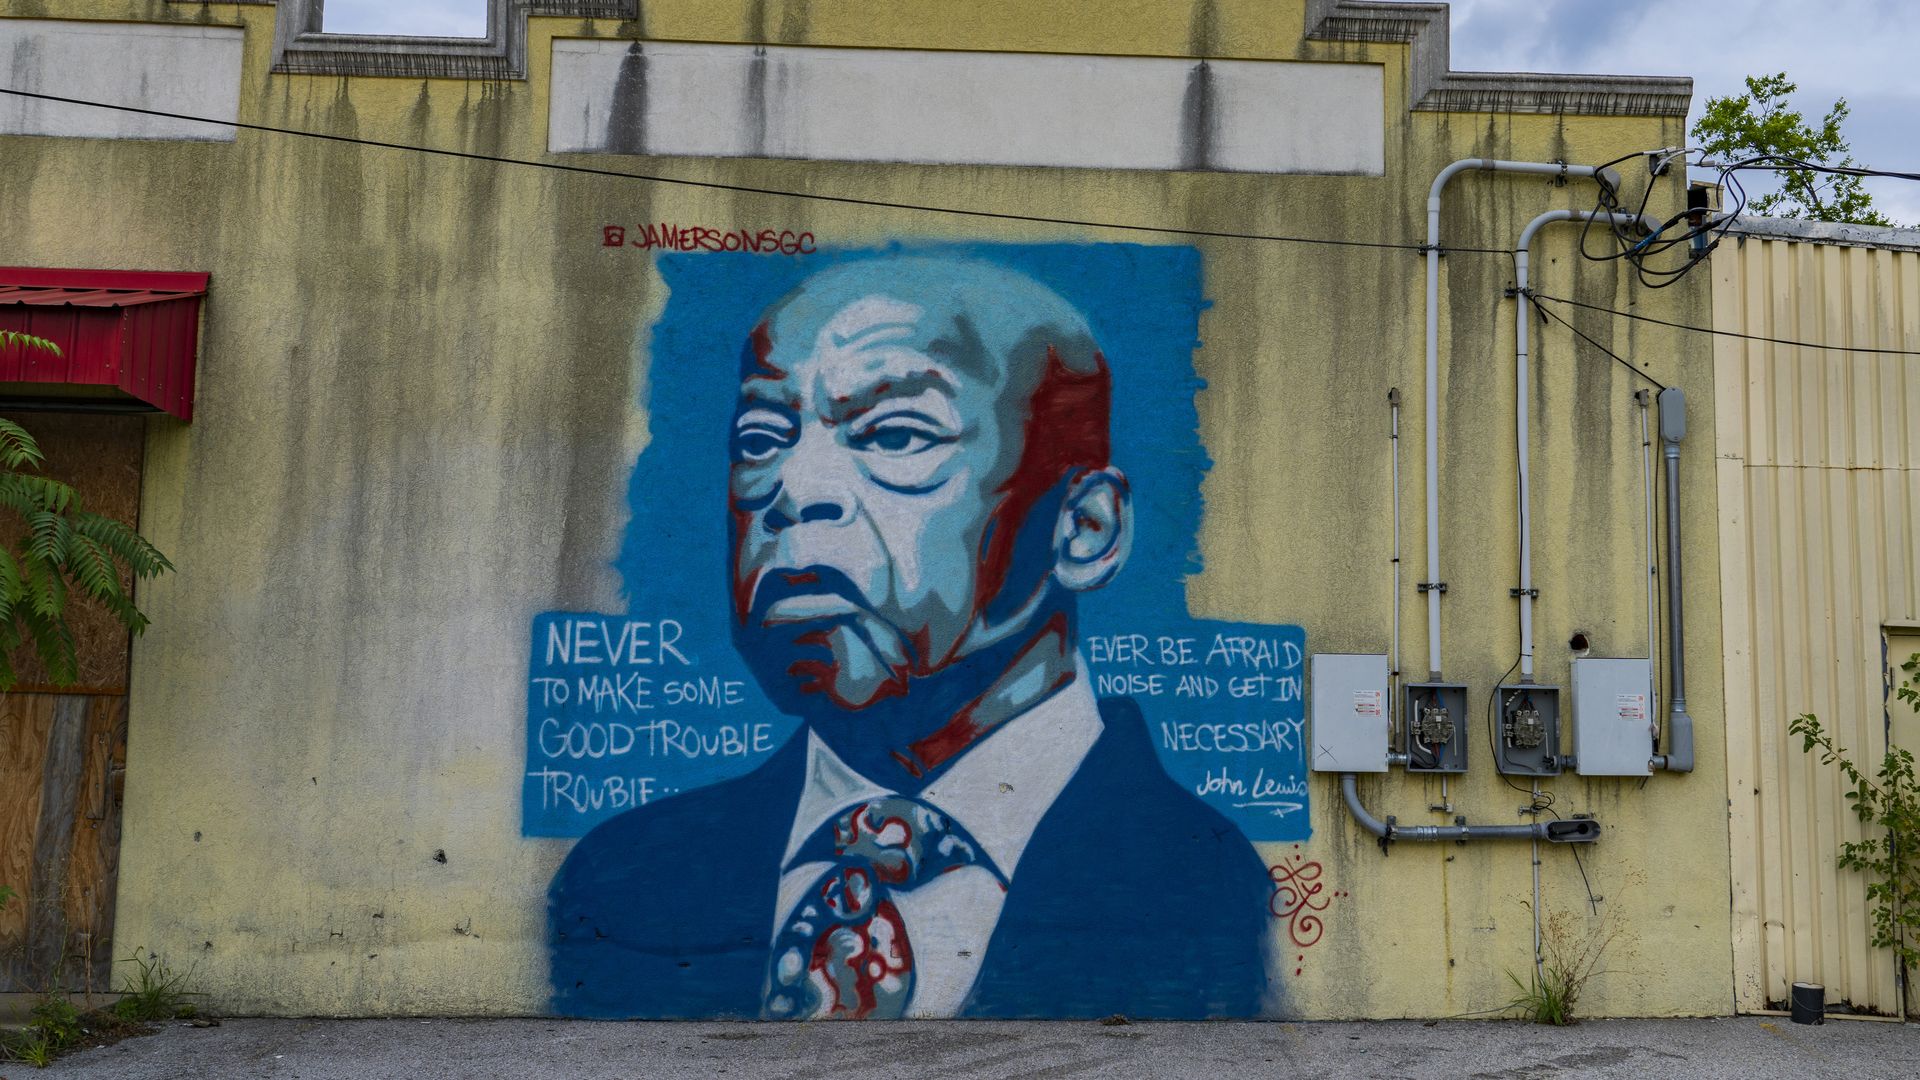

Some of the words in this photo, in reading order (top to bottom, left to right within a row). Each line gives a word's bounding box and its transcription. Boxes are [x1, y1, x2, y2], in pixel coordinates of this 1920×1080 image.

[545, 619, 691, 666] NEVER
[1087, 634, 1155, 667] EVER
[1157, 635, 1198, 666] BE
[1205, 633, 1302, 670] AFRAID
[532, 677, 570, 708] TO
[577, 672, 654, 714] MAKE
[663, 676, 745, 709] SOME
[1098, 673, 1167, 696] NOISE
[1175, 674, 1219, 699] AND
[1228, 673, 1273, 698] GET
[1271, 674, 1302, 702] IN
[539, 717, 635, 759] GOOD
[1161, 717, 1306, 761] NECESSARY
[1196, 766, 1248, 796] John
[1251, 767, 1309, 799] Lewis
